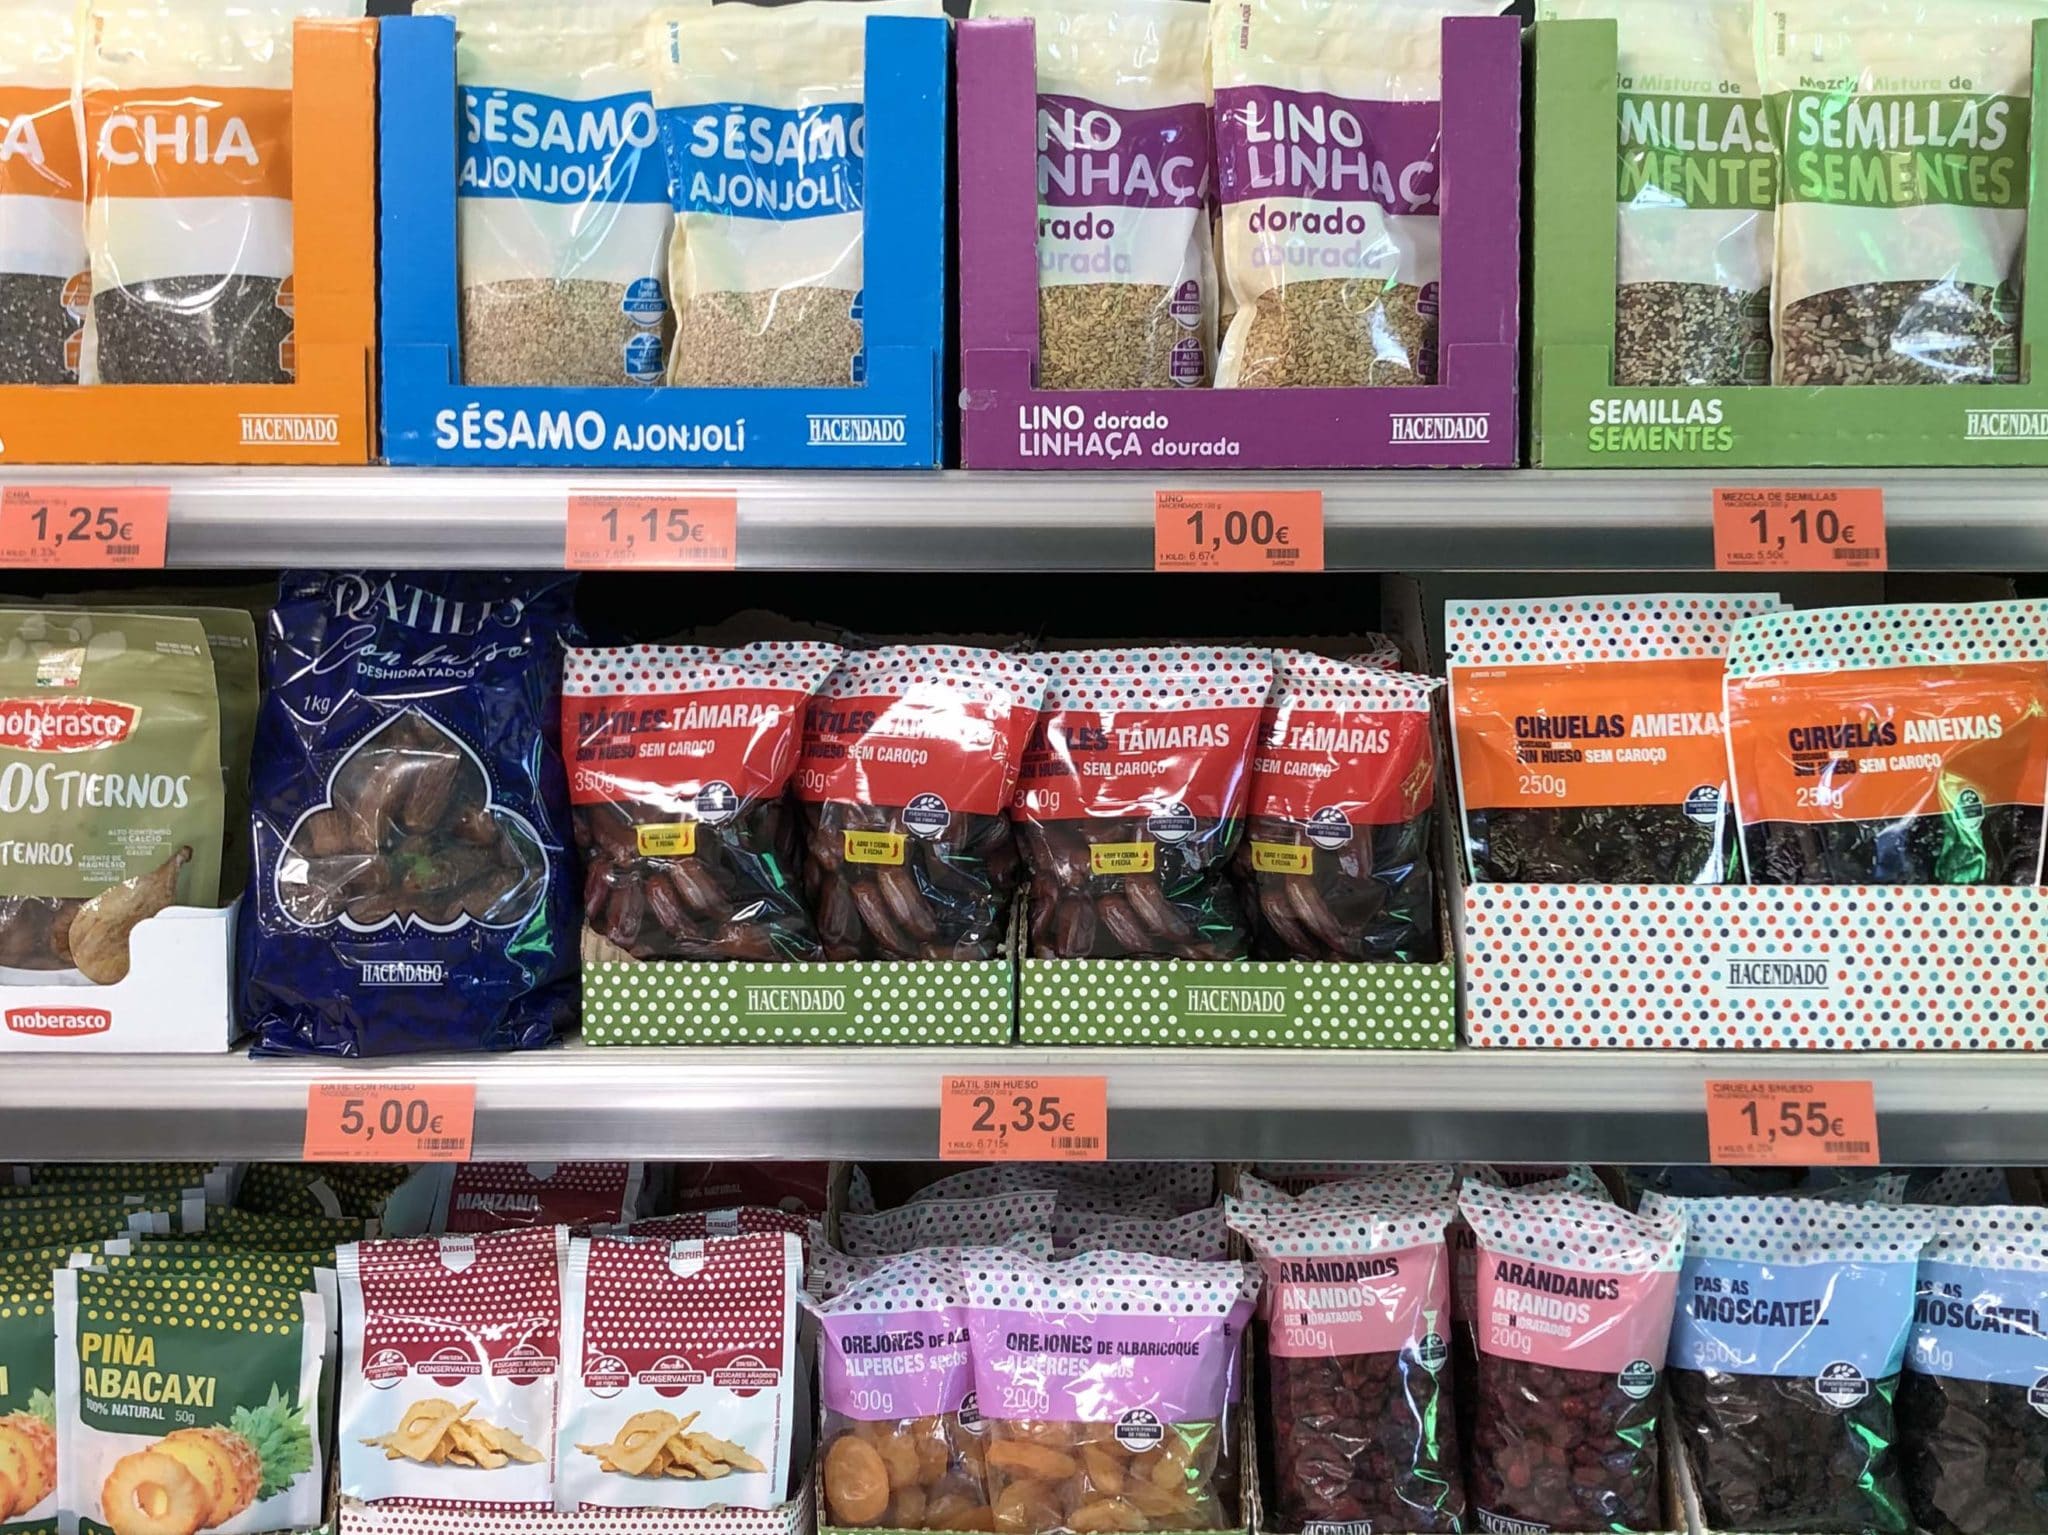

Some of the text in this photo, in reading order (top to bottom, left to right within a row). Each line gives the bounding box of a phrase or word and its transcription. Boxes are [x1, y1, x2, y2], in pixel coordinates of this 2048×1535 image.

[1718, 74, 1741, 93] de
[1948, 75, 1973, 91] de
[465, 91, 658, 149] SÉSAMO
[1038, 108, 1122, 152] NO
[1246, 100, 1363, 148] LINO
[1619, 99, 1778, 154] MILLAS
[1797, 95, 2010, 152] SEMILLAS
[101, 115, 260, 166] CHIA
[459, 153, 614, 195] AJONJOLÍ
[1038, 153, 1209, 205] NHAÇ
[1247, 143, 1440, 213] LINHAÇ
[1619, 156, 1772, 205] MENTE
[1798, 152, 2015, 205] SEMENTES
[690, 164, 843, 212] AJONJOLÍ
[1038, 213, 1115, 241] rado
[1248, 204, 1366, 237] dorado
[1019, 405, 1169, 431] LINO dorado
[1588, 398, 1724, 425] SEMILLAS
[241, 417, 338, 442] HACENDADO
[435, 403, 746, 452] SÉSAMO AJONJOLÍ
[809, 418, 906, 444] HACENDADO
[1391, 417, 1489, 441] HACENDADO
[1967, 413, 2048, 437] HACENDAD
[1019, 432, 1241, 461] LINHAÇA dourada
[1588, 425, 1734, 453] SEMENTES
[1159, 495, 1183, 503] LINO
[1722, 493, 1837, 501] MEZCLA DE SEMILLAS
[31, 506, 134, 548] 1,25€
[601, 507, 705, 549] 1,15€
[1186, 510, 1290, 552] 1,00€
[1750, 509, 1856, 550] 1,10€
[356, 664, 476, 680] DESHIDRATADOS
[303, 694, 332, 714] 1kg
[672, 701, 780, 732] TÂMARAS
[1115, 721, 1230, 752] TÂMARAS
[1290, 721, 1391, 754] TÂMARAS
[1515, 714, 1625, 739] CIRUELAS
[1788, 713, 2003, 751] CIRUELAS AMEIXAS
[639, 743, 666, 758] SEM
[848, 745, 873, 761] SEM
[877, 747, 928, 768] CAROÇO
[1517, 747, 1667, 765] SIN HUESO SEM CAROÇO
[1859, 758, 1887, 774] SEM
[1889, 753, 1942, 773] CAROÇO
[1083, 761, 1111, 776] SEM
[1253, 758, 1281, 773] SEM
[55, 771, 191, 811] TIERNOS
[1518, 774, 1567, 797] 250g
[362, 963, 443, 983] HACENDADO
[1729, 963, 1828, 985] HACENDADO
[747, 989, 846, 1011] HACENDADO
[1187, 989, 1286, 1012] HACENDADO
[12, 1011, 106, 1029] noberasco
[984, 1080, 1000, 1089] SIN
[1003, 1080, 1039, 1089] HUESO
[1713, 1084, 1764, 1093] CIRUELAS
[340, 1099, 444, 1141] 5,00€
[971, 1096, 1076, 1139] 2,35€
[1741, 1101, 1845, 1143] 1,55€
[456, 1193, 539, 1212] MANZANA
[441, 1244, 475, 1254] ABRIR
[671, 1250, 705, 1261] ABRIR
[1280, 1257, 1400, 1284] ARÁNDANOS
[1494, 1260, 1620, 1300] ARÁNDANOS
[1283, 1286, 1376, 1310] ARANDOS
[1492, 1287, 1592, 1325] ARANDOS
[1693, 1294, 1830, 1328] MOSCATEL
[81, 1327, 156, 1368] PIÑA
[841, 1331, 925, 1354] OREJONES
[1006, 1332, 1200, 1356] OREJONES DE ALBARICOQUE
[1286, 1328, 1328, 1349] 200g
[1490, 1326, 1533, 1354] 200g
[419, 1365, 481, 1374] CONSERVANTES
[845, 1353, 925, 1377] ALPERCES
[84, 1367, 217, 1408] ABACAXI
[641, 1374, 702, 1384] CONSERVANTES
[112, 1404, 166, 1421] NATURAL
[175, 1410, 196, 1425] 50g
